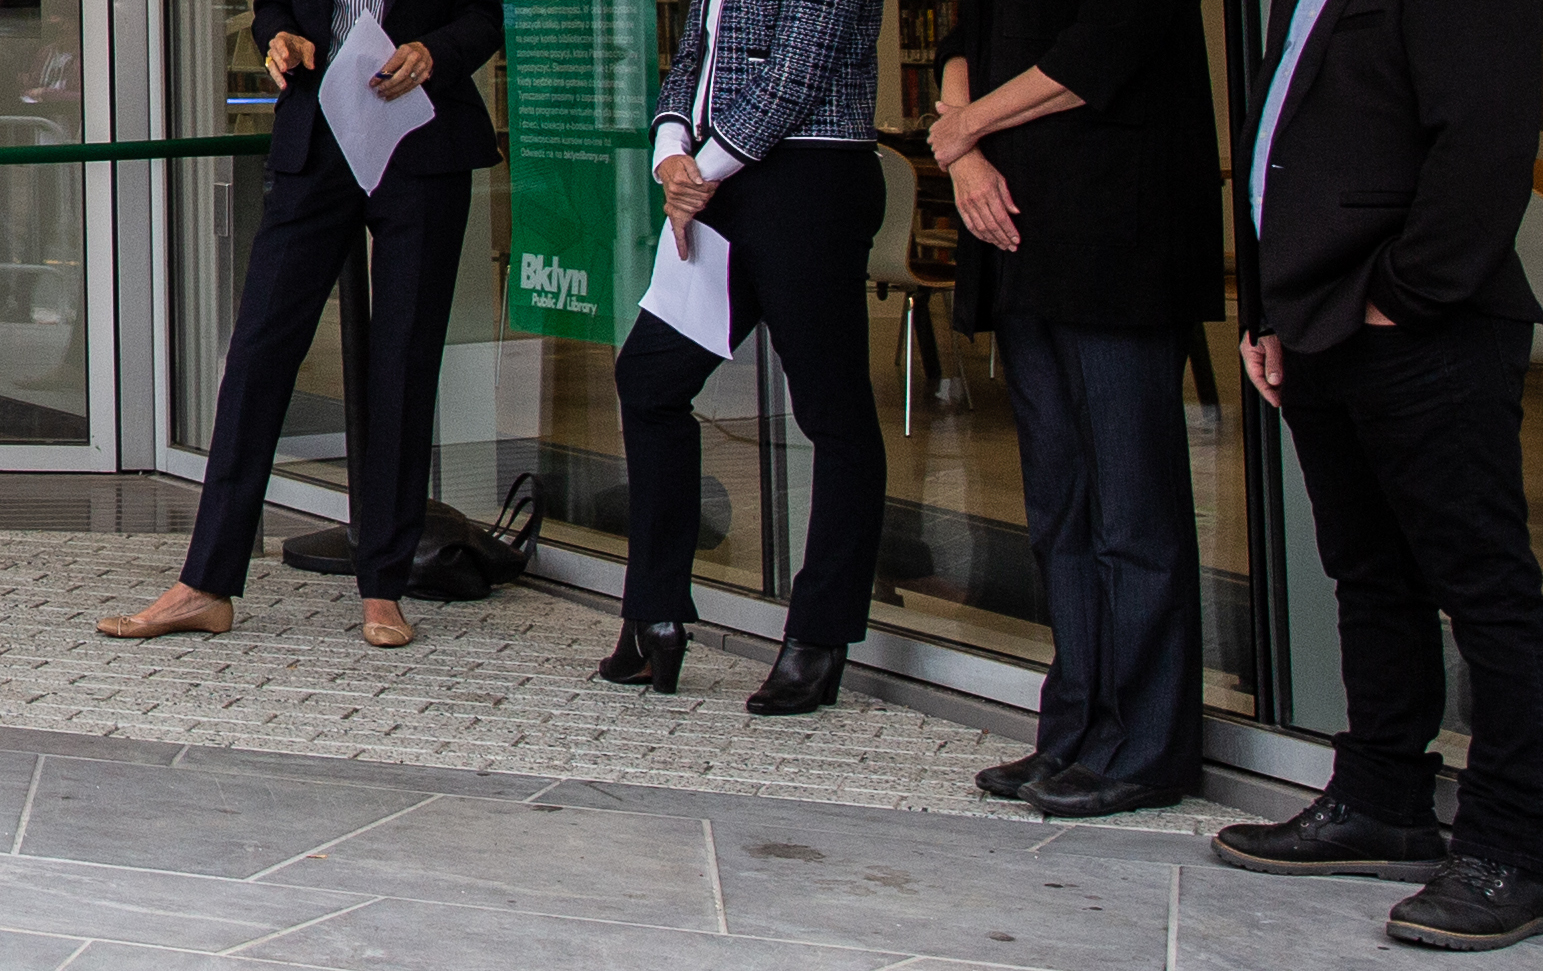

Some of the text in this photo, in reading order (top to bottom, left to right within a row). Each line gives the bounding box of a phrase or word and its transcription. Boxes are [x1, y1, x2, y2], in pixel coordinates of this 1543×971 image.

[521, 252, 588, 310] Bklyn
[531, 292, 598, 317] Public Library
